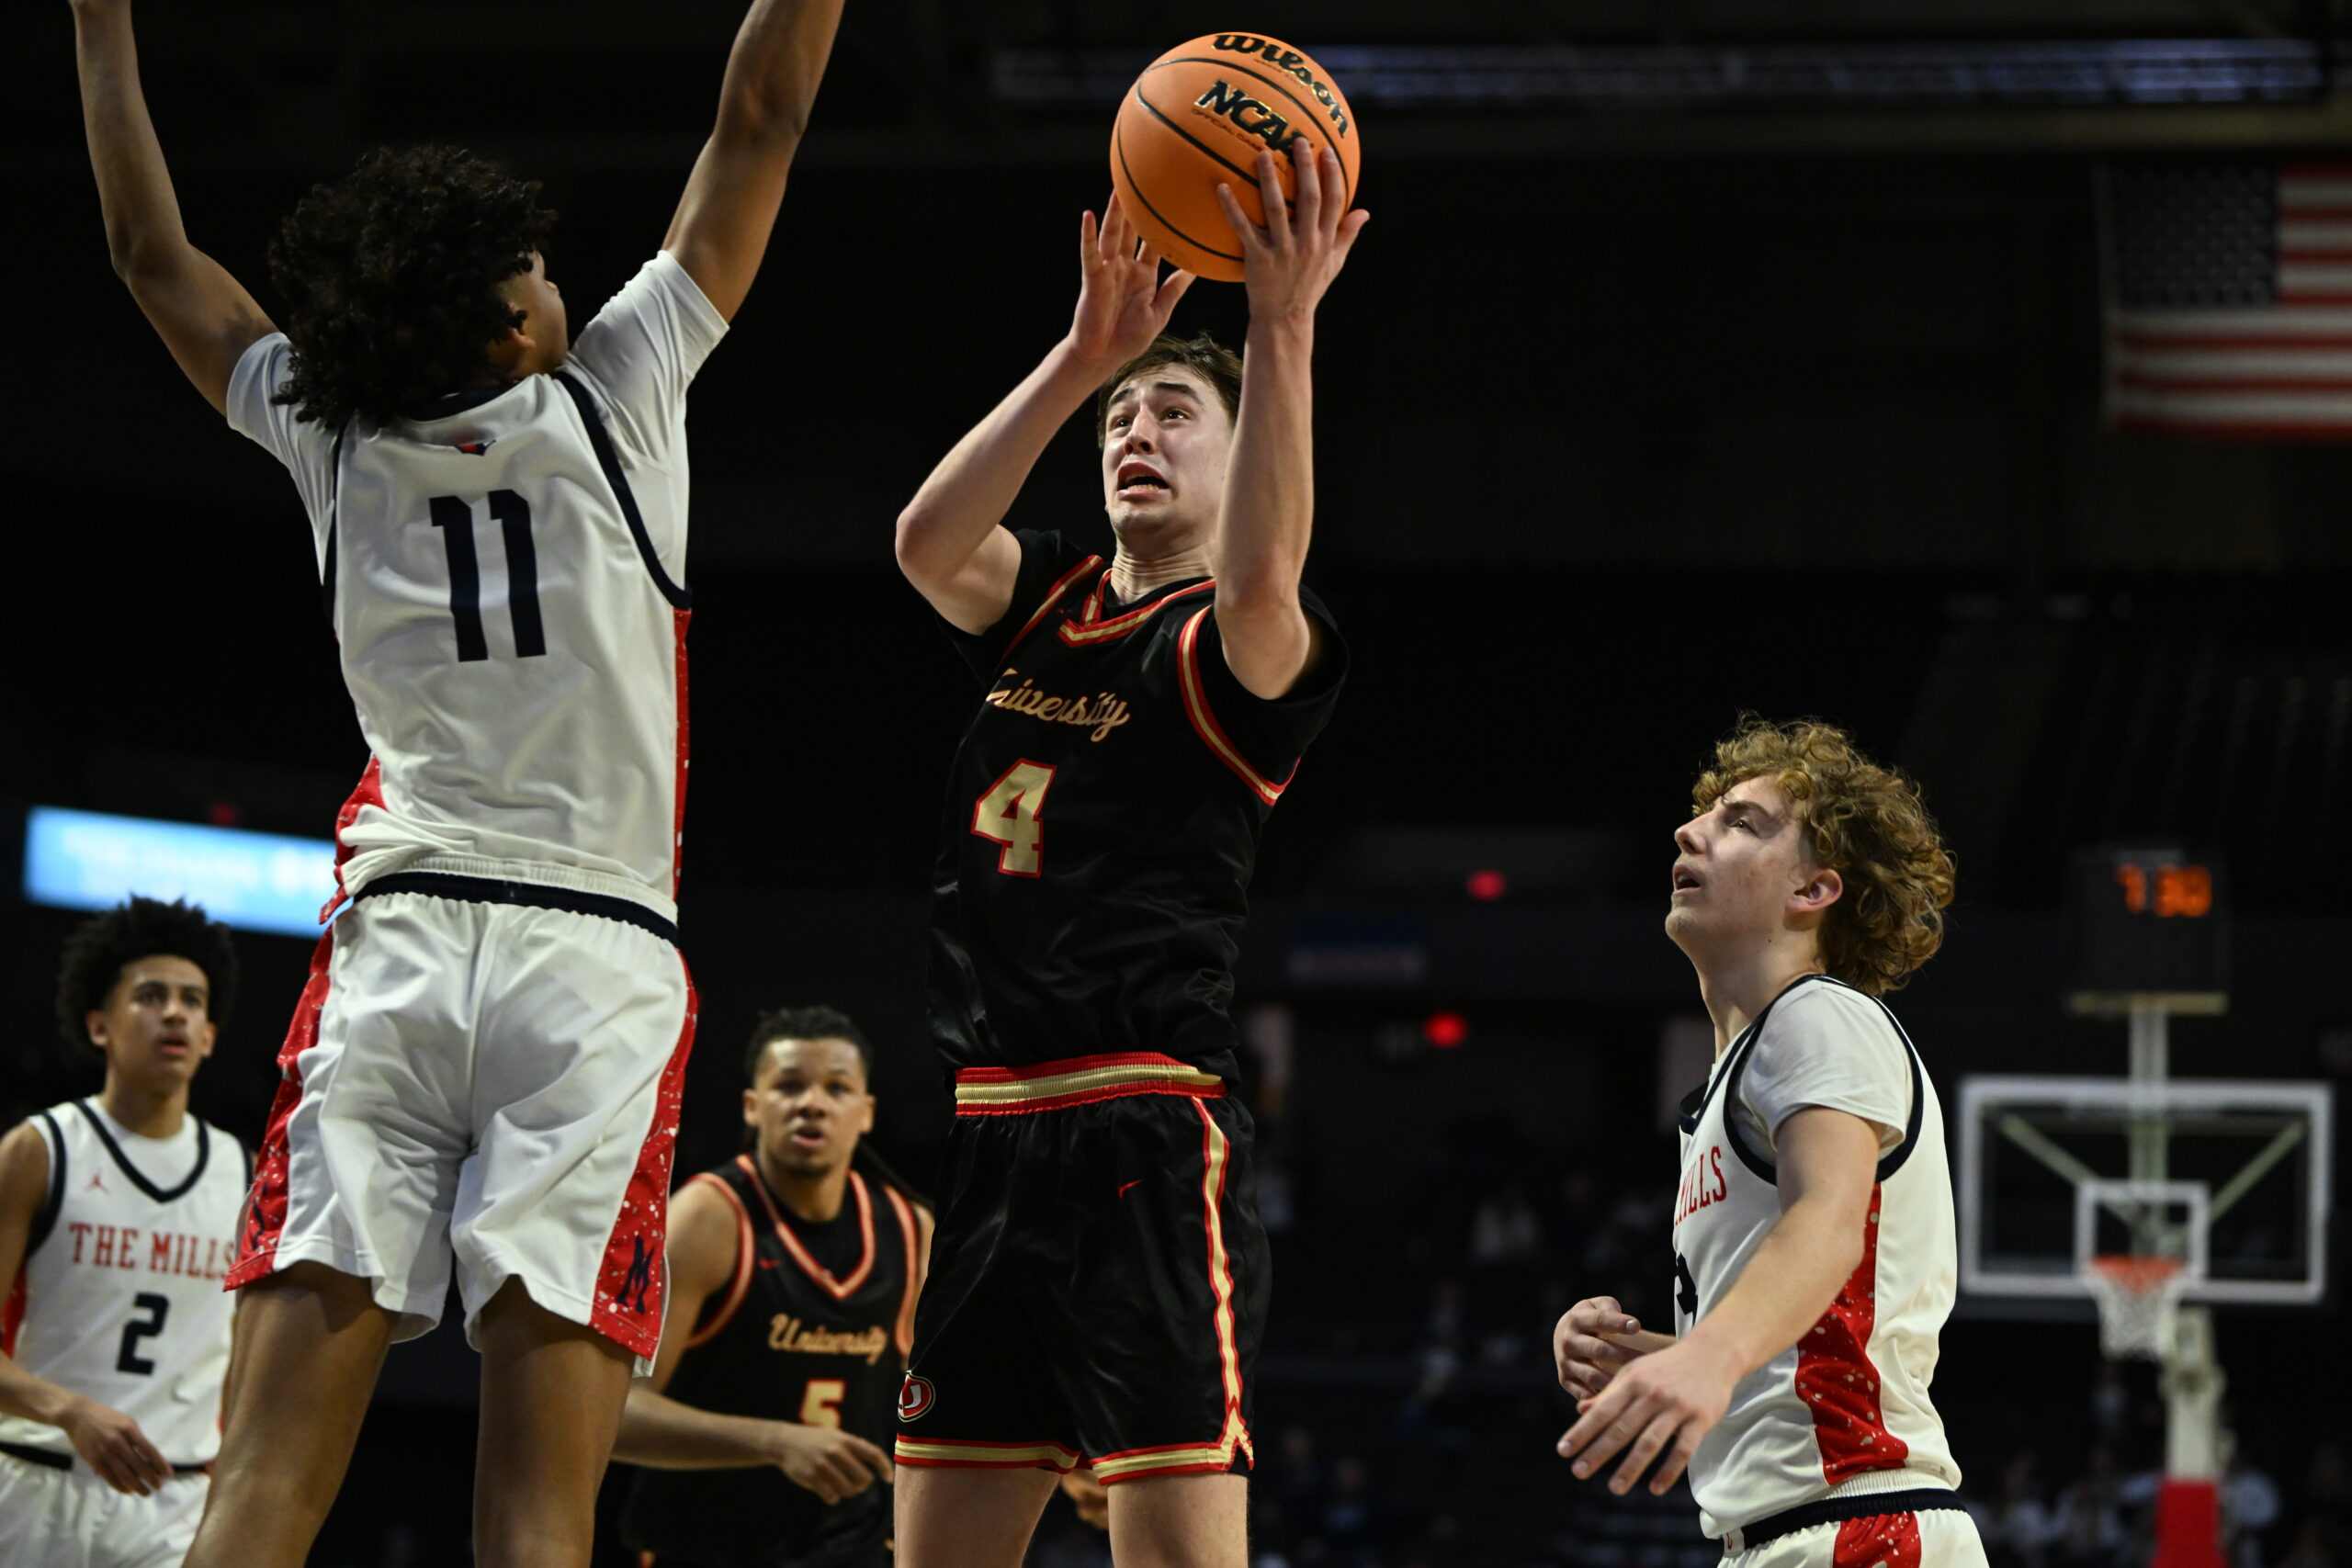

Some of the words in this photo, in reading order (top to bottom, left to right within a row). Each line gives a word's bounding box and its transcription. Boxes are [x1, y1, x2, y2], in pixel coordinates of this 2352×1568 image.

[429, 489, 547, 662] 11
[971, 758, 1057, 878] 4
[70, 1223, 140, 1269] THE
[149, 1233, 237, 1280] MILLS
[116, 1292, 170, 1376] 2
[799, 1379, 845, 1429] 5
